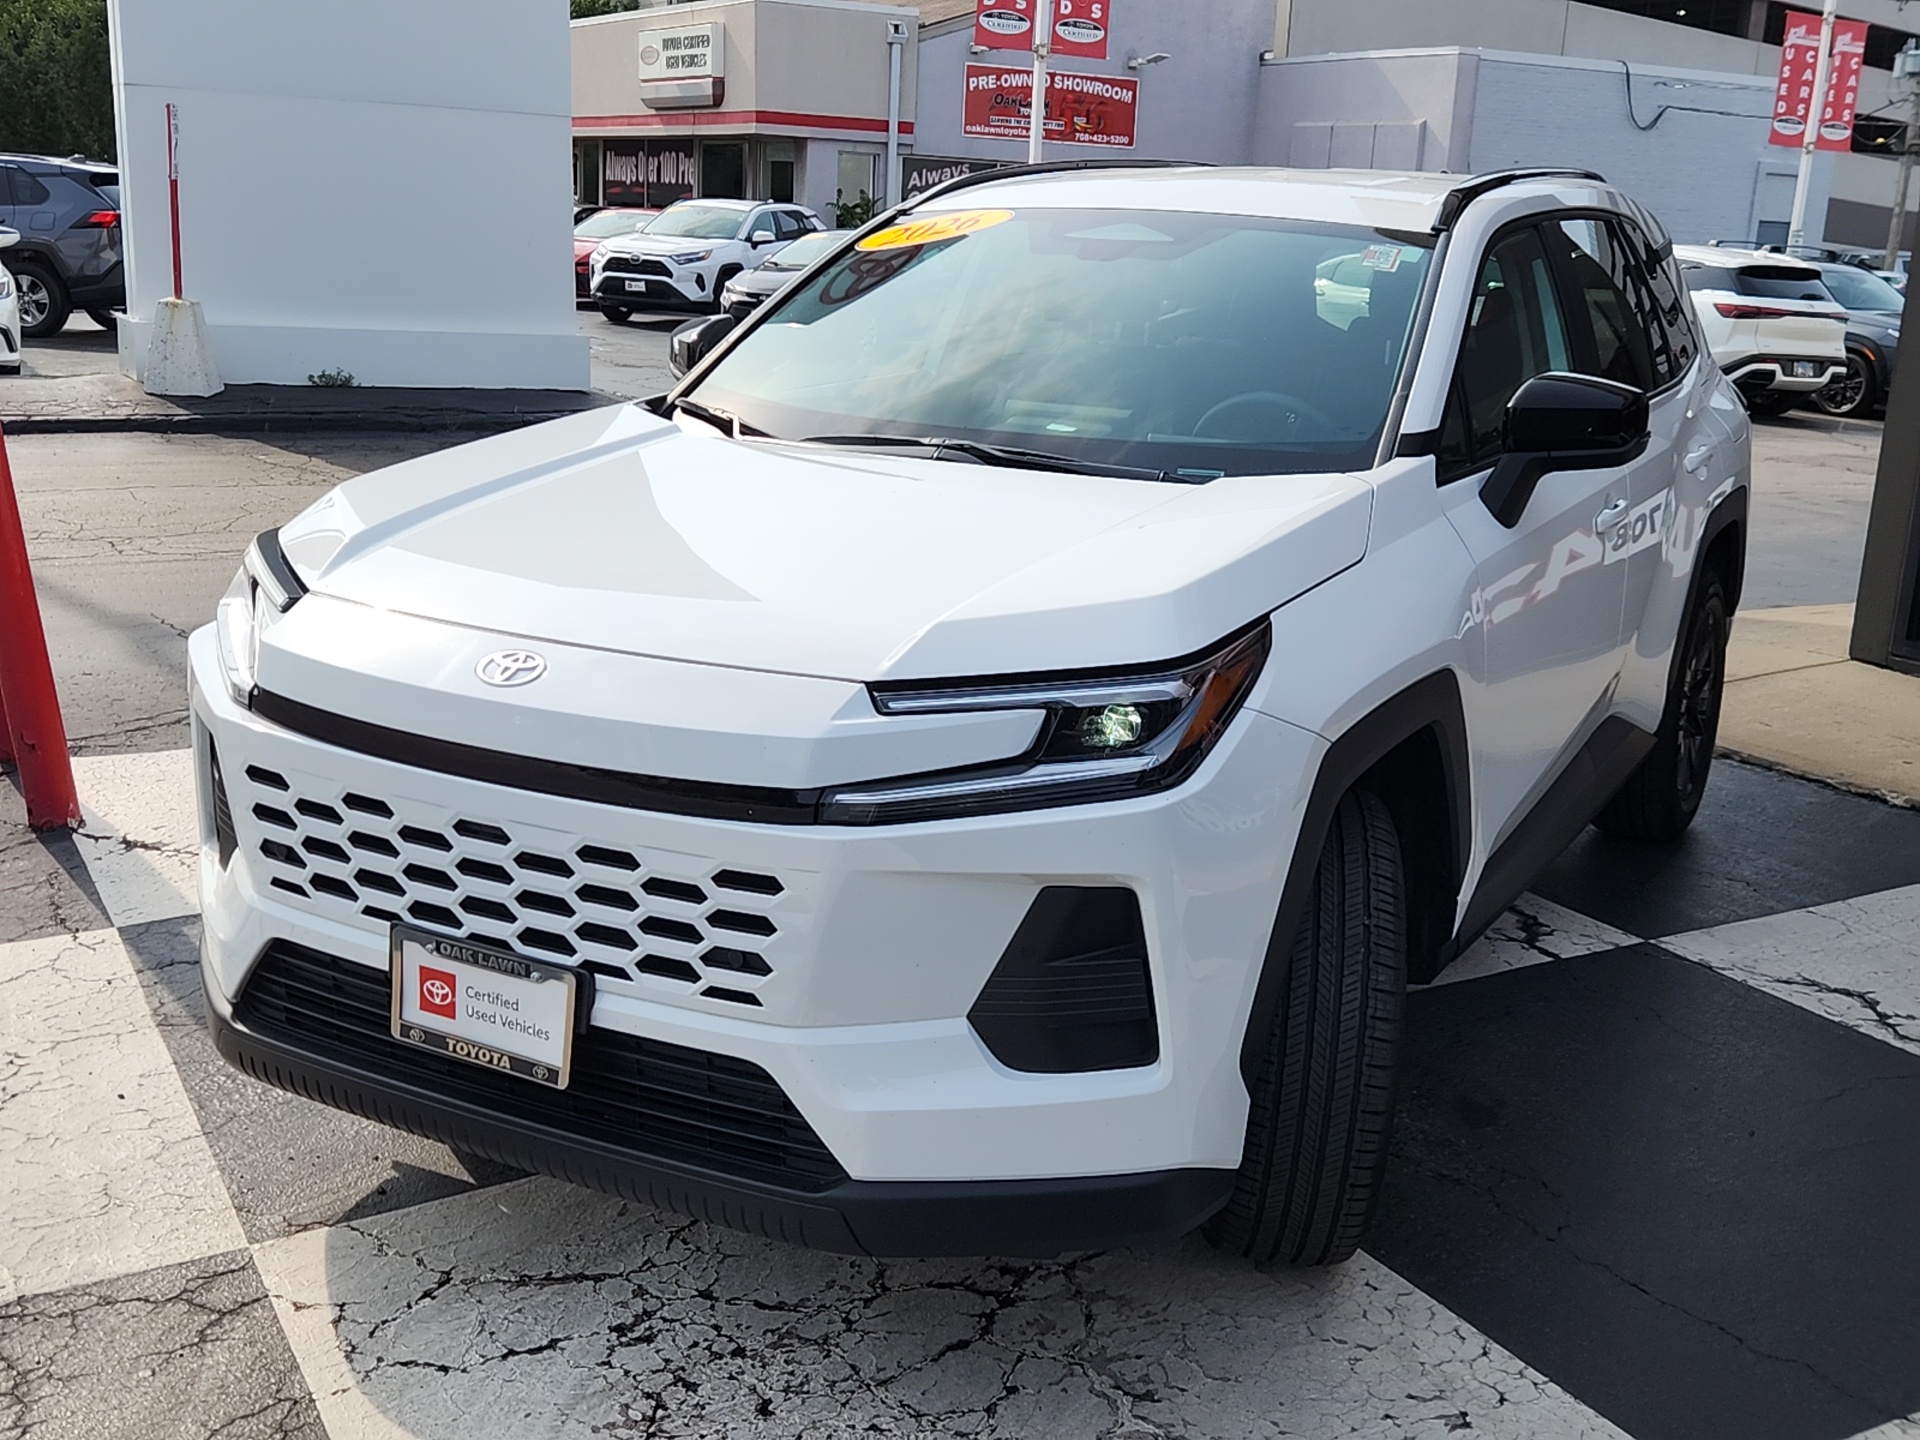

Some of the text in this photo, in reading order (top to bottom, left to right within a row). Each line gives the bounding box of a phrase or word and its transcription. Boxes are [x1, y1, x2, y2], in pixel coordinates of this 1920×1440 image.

[969, 73, 1133, 103] PRE-OWND SHOWROOM
[605, 150, 637, 185] Always
[638, 150, 659, 184] Oer
[660, 151, 677, 184] 100
[439, 942, 527, 977] OAK LAWN
[465, 985, 520, 1012] Certified
[465, 1004, 551, 1042] Used Vehicles
[445, 1037, 512, 1070] TOYOTA
